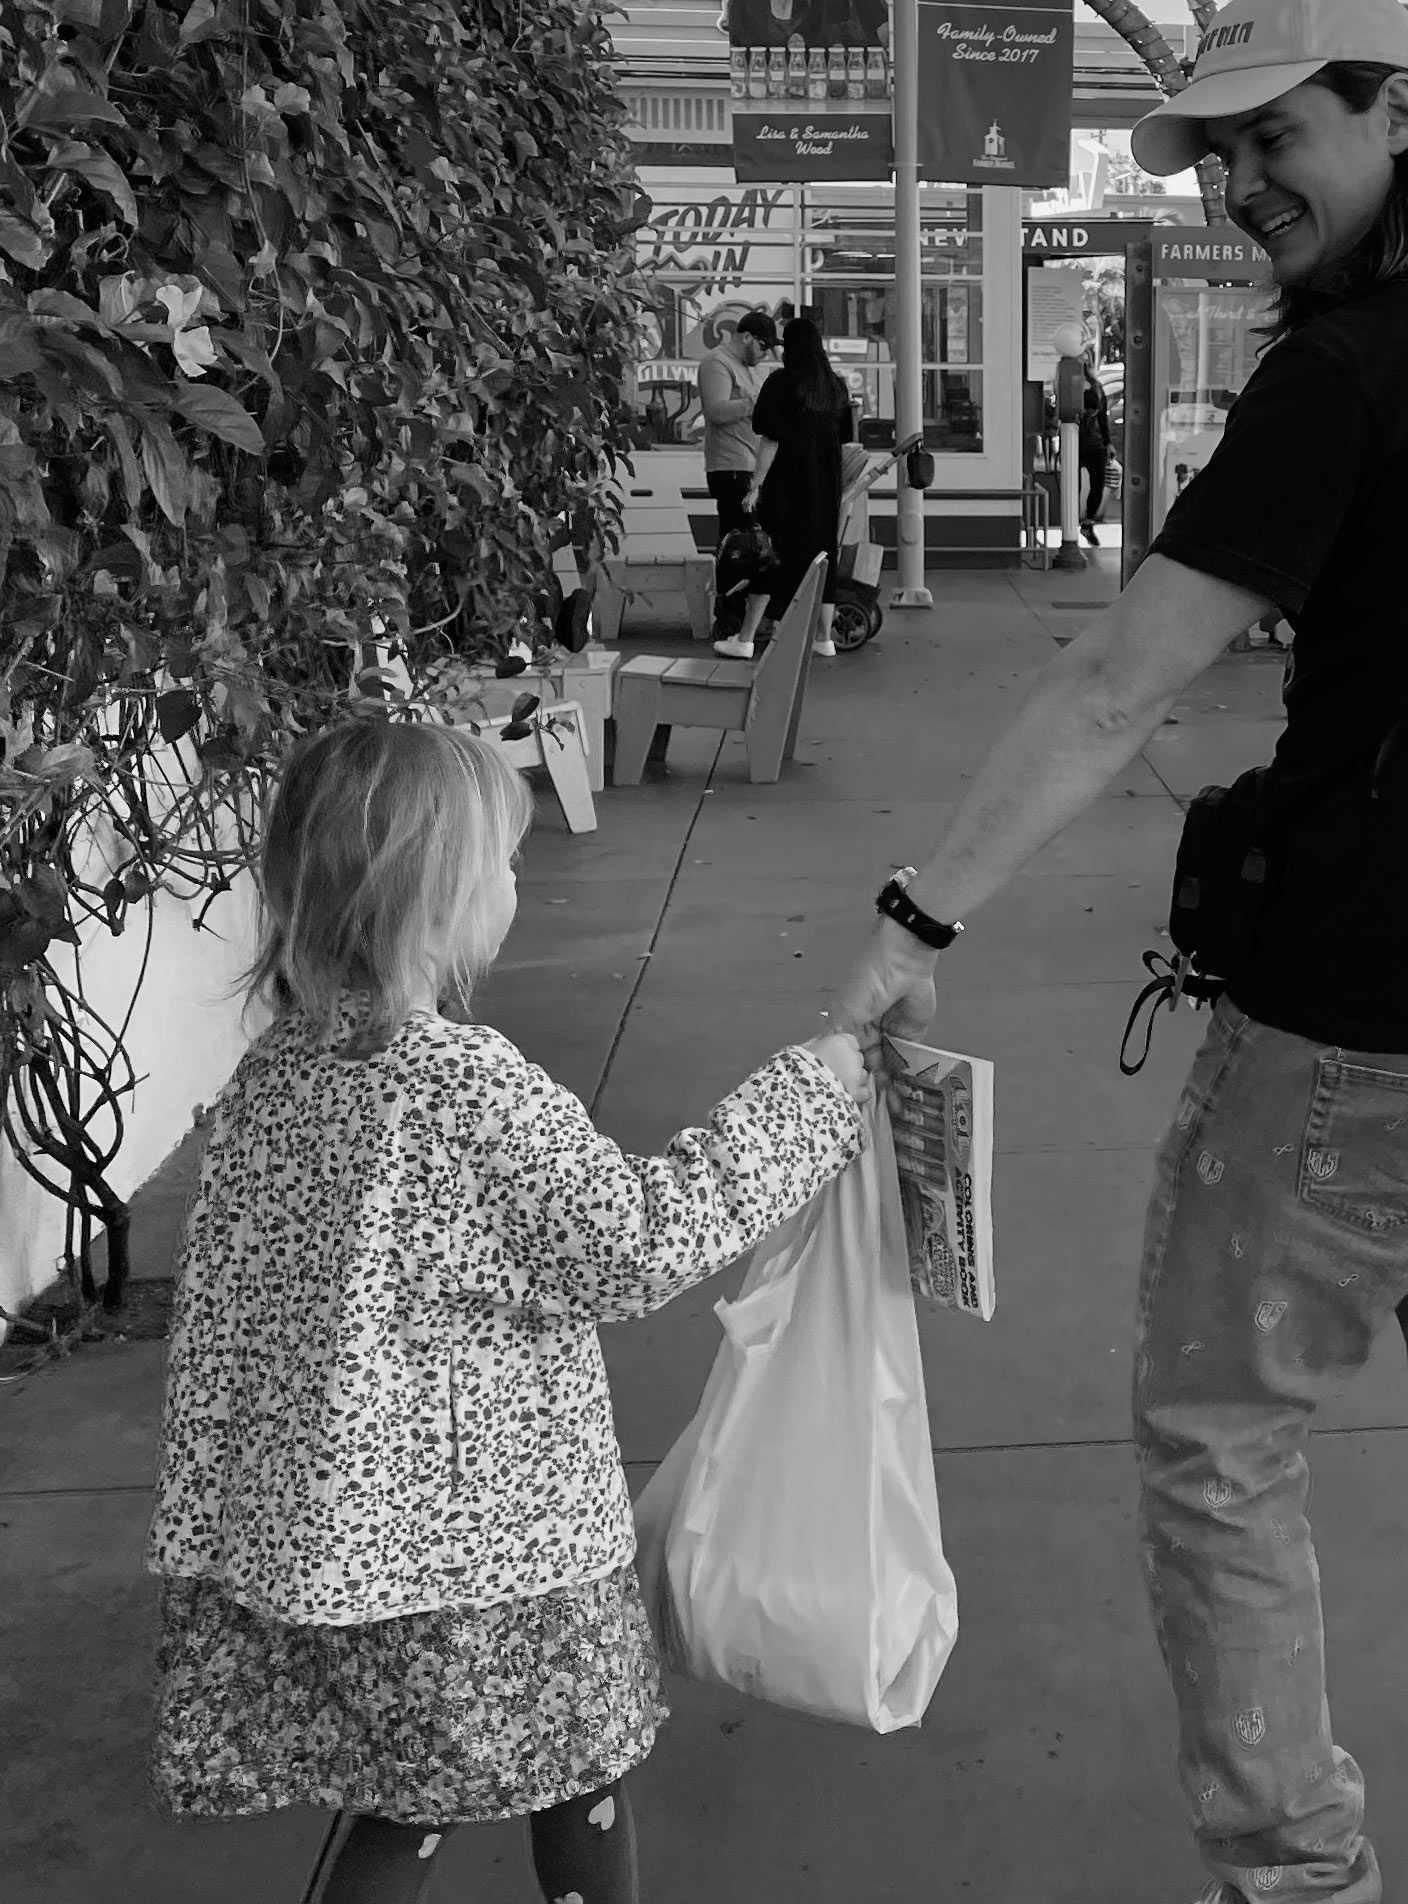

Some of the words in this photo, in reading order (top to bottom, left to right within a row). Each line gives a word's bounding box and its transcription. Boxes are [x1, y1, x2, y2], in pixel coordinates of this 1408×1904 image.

[937, 22, 1058, 47] Family-Owned
[952, 43, 996, 62] Since
[998, 48, 1040, 63] 2017
[756, 124, 786, 140] Lisa
[789, 126, 799, 140] &
[802, 124, 870, 140] Samantha
[795, 140, 833, 155] Wood
[650, 188, 785, 257] TODAY
[1161, 243, 1244, 261] FARMERS
[704, 240, 751, 296] IN
